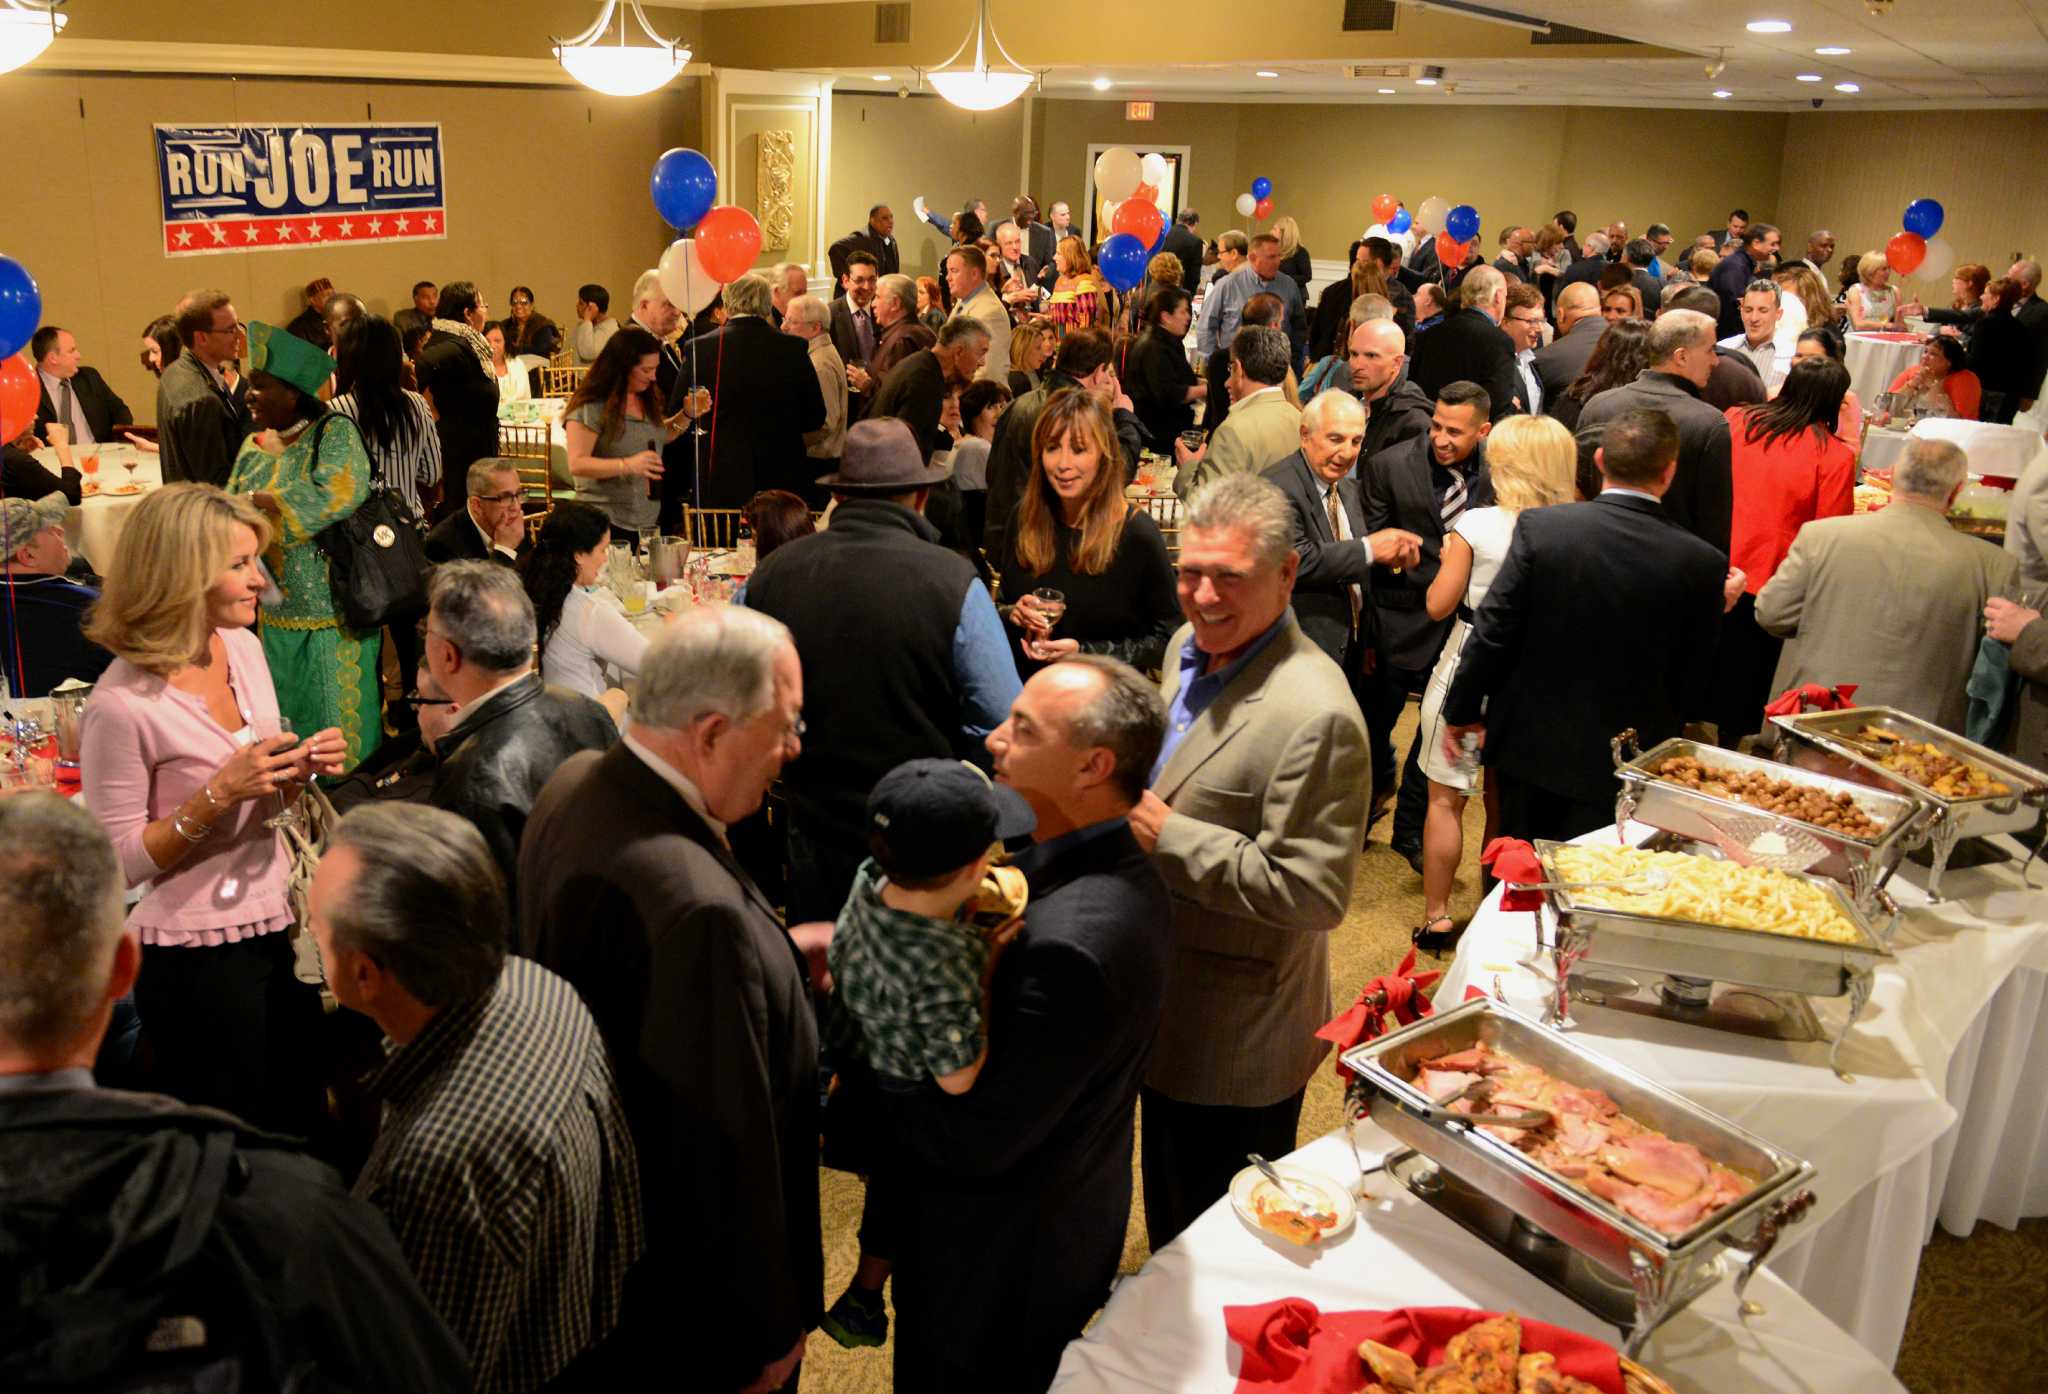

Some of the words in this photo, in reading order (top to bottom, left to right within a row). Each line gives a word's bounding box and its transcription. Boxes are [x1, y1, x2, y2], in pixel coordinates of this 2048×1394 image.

[166, 152, 246, 195] RUN
[254, 134, 368, 208] JOE
[371, 148, 435, 188] RUN
